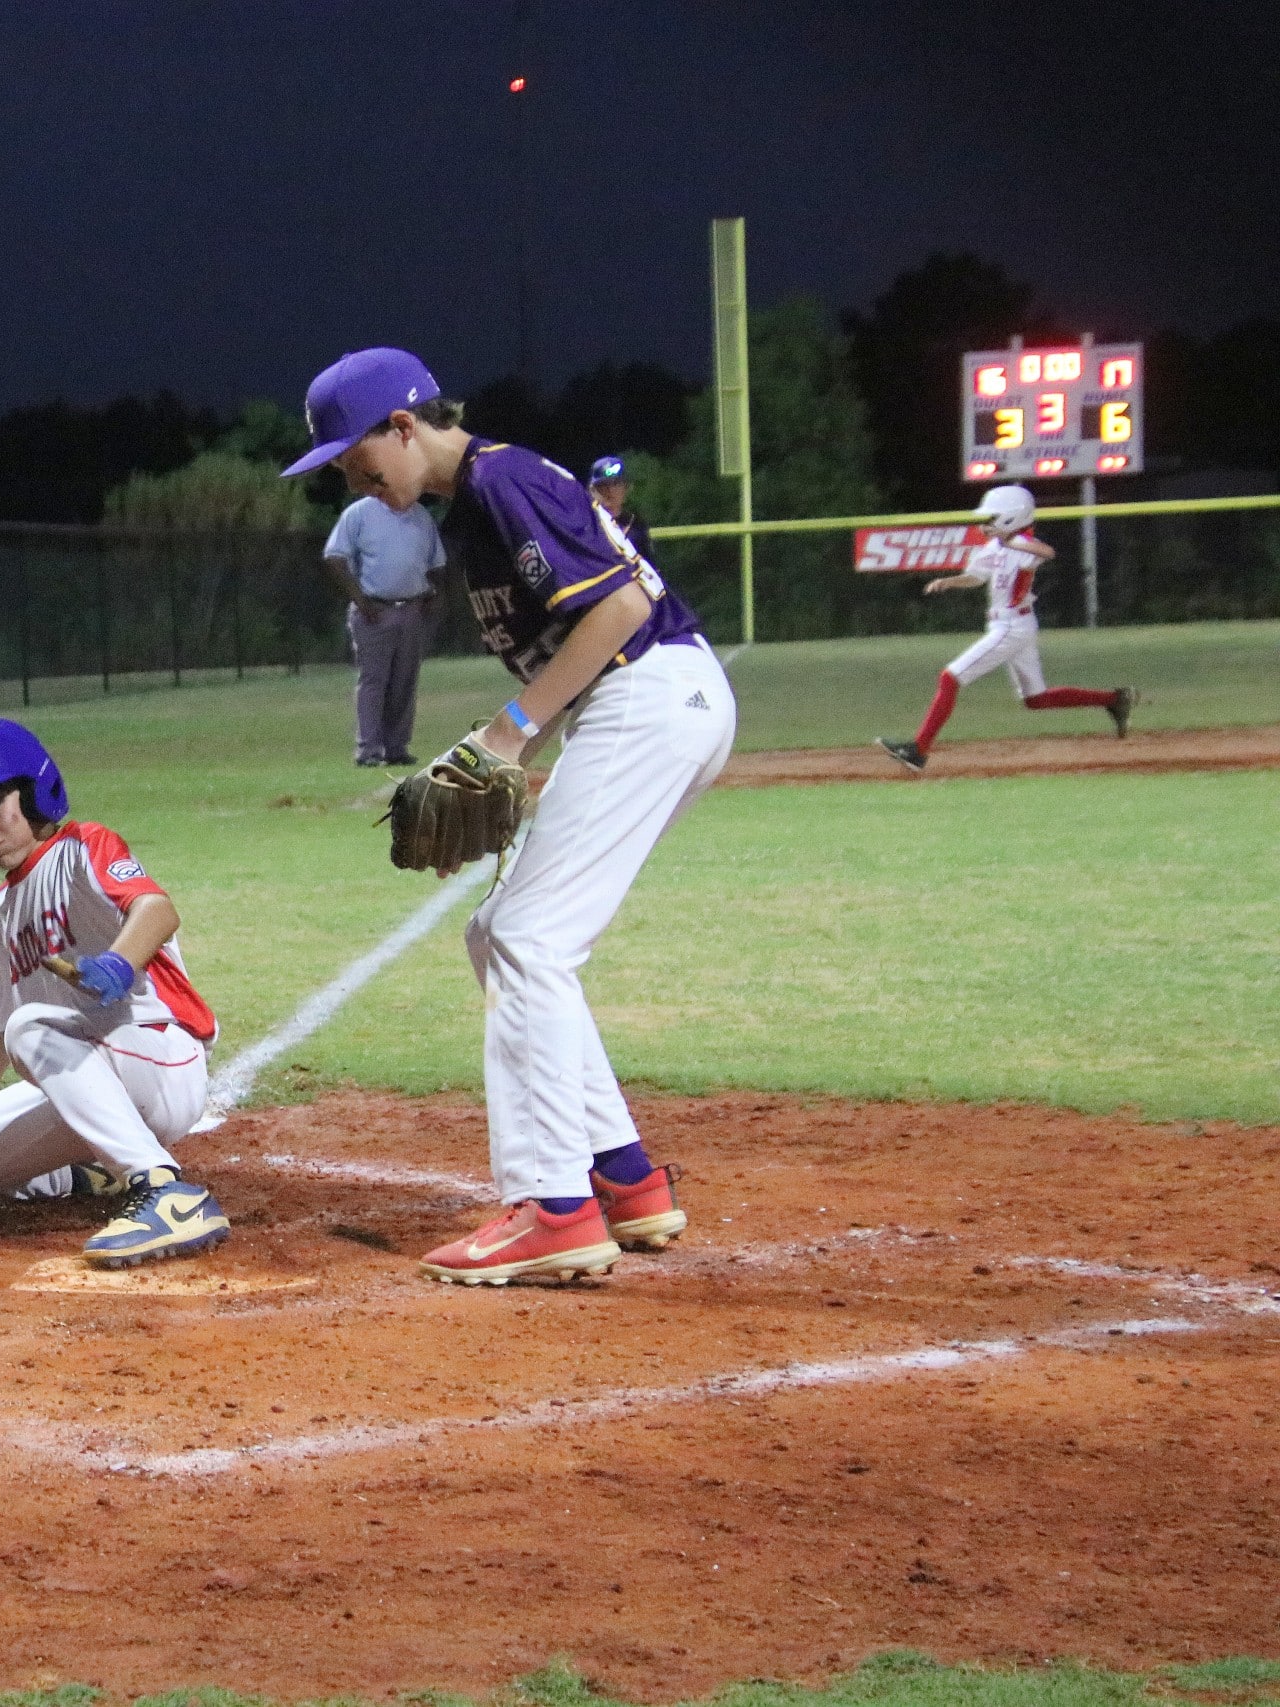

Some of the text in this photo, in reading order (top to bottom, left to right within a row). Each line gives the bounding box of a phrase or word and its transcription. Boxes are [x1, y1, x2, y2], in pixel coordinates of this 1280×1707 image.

[977, 366, 1007, 396] 6
[995, 408, 1024, 449] 3
[1038, 393, 1065, 432] 3
[1100, 402, 1131, 443] 6
